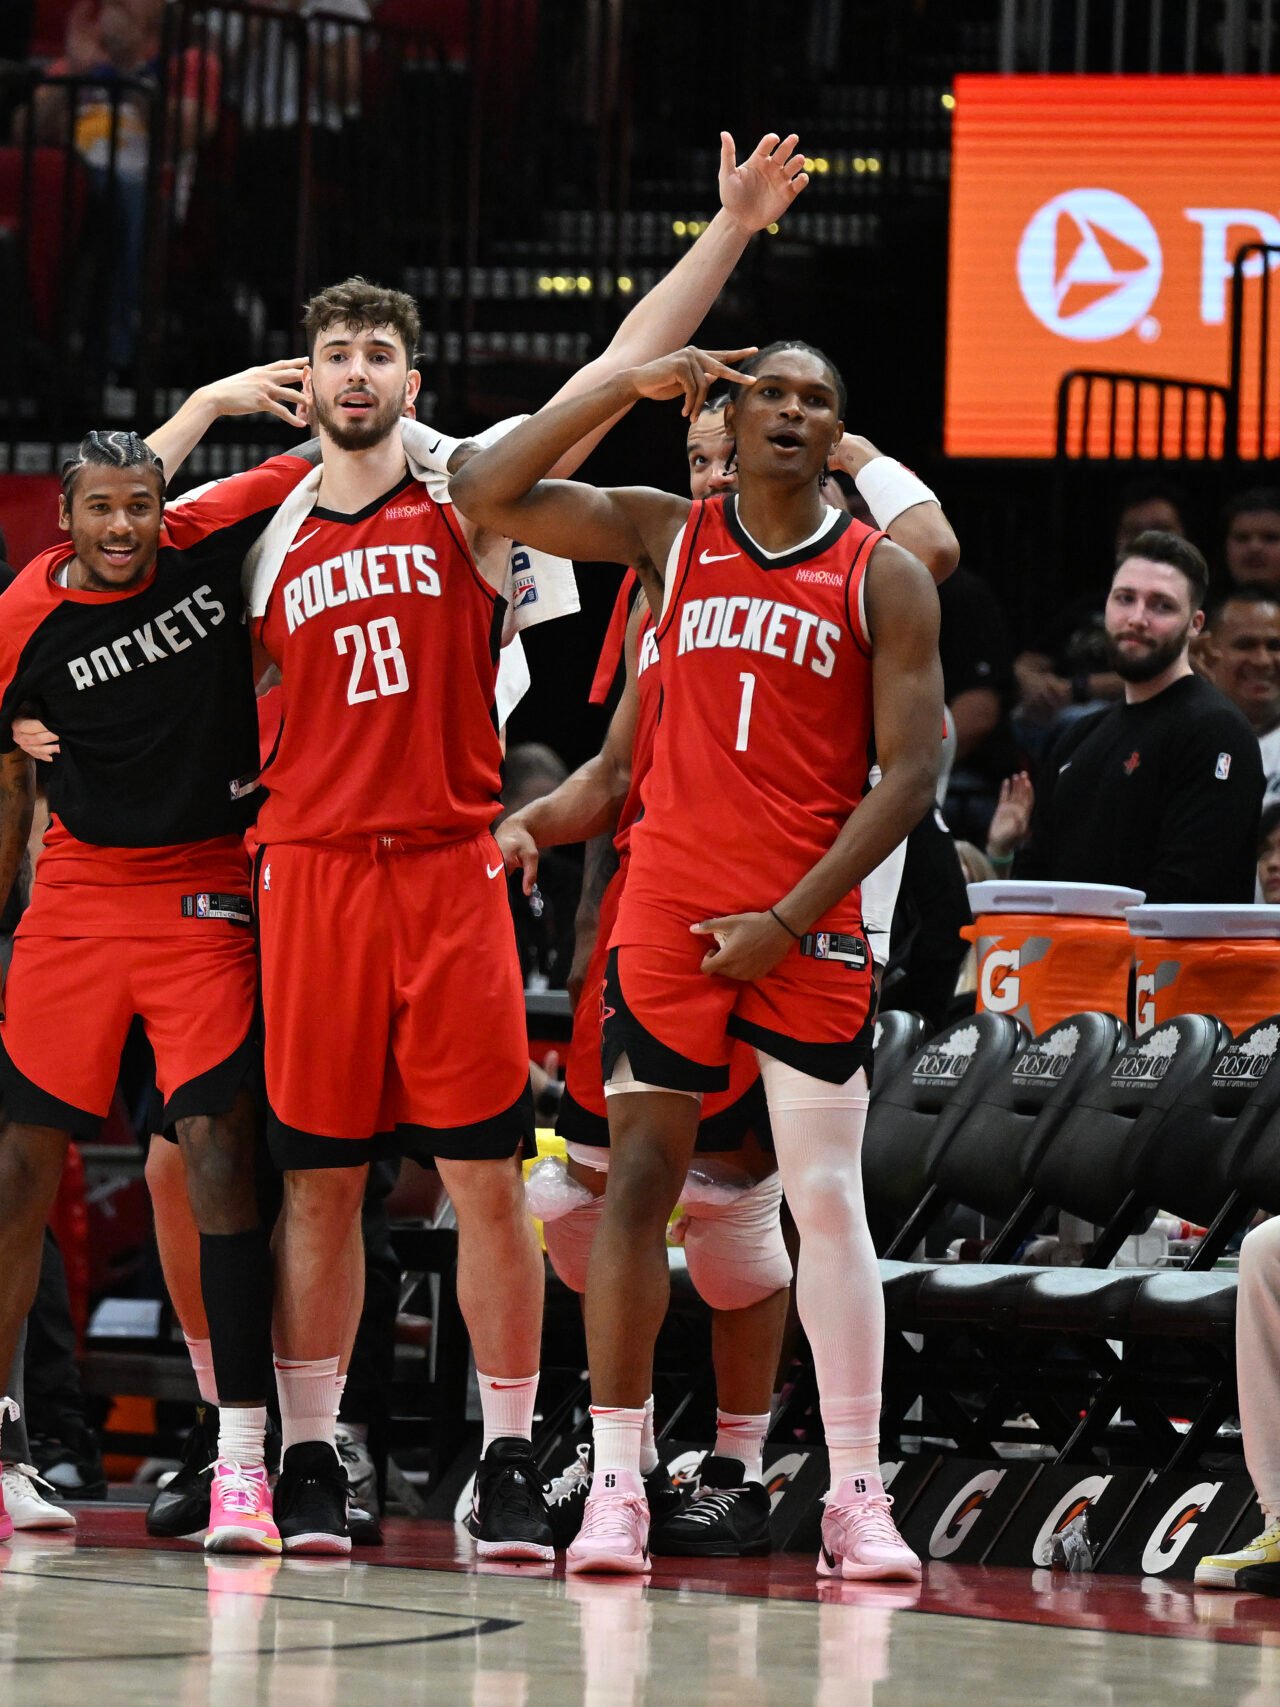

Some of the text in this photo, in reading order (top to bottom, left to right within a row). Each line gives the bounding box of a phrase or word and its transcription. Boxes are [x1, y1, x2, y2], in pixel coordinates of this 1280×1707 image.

[283, 544, 442, 635] ROCKETS
[67, 584, 226, 691] ROCKETS
[333, 616, 410, 705] 28
[677, 596, 842, 679] ROCKETS
[735, 672, 756, 751] 1
[981, 949, 1020, 1012] G
[914, 1055, 952, 1074] POST
[1014, 1055, 1051, 1074] POST
[1114, 1057, 1151, 1075] POST
[1214, 1056, 1251, 1075] POST
[929, 1469, 1007, 1559] G
[1141, 1482, 1223, 1575] G
